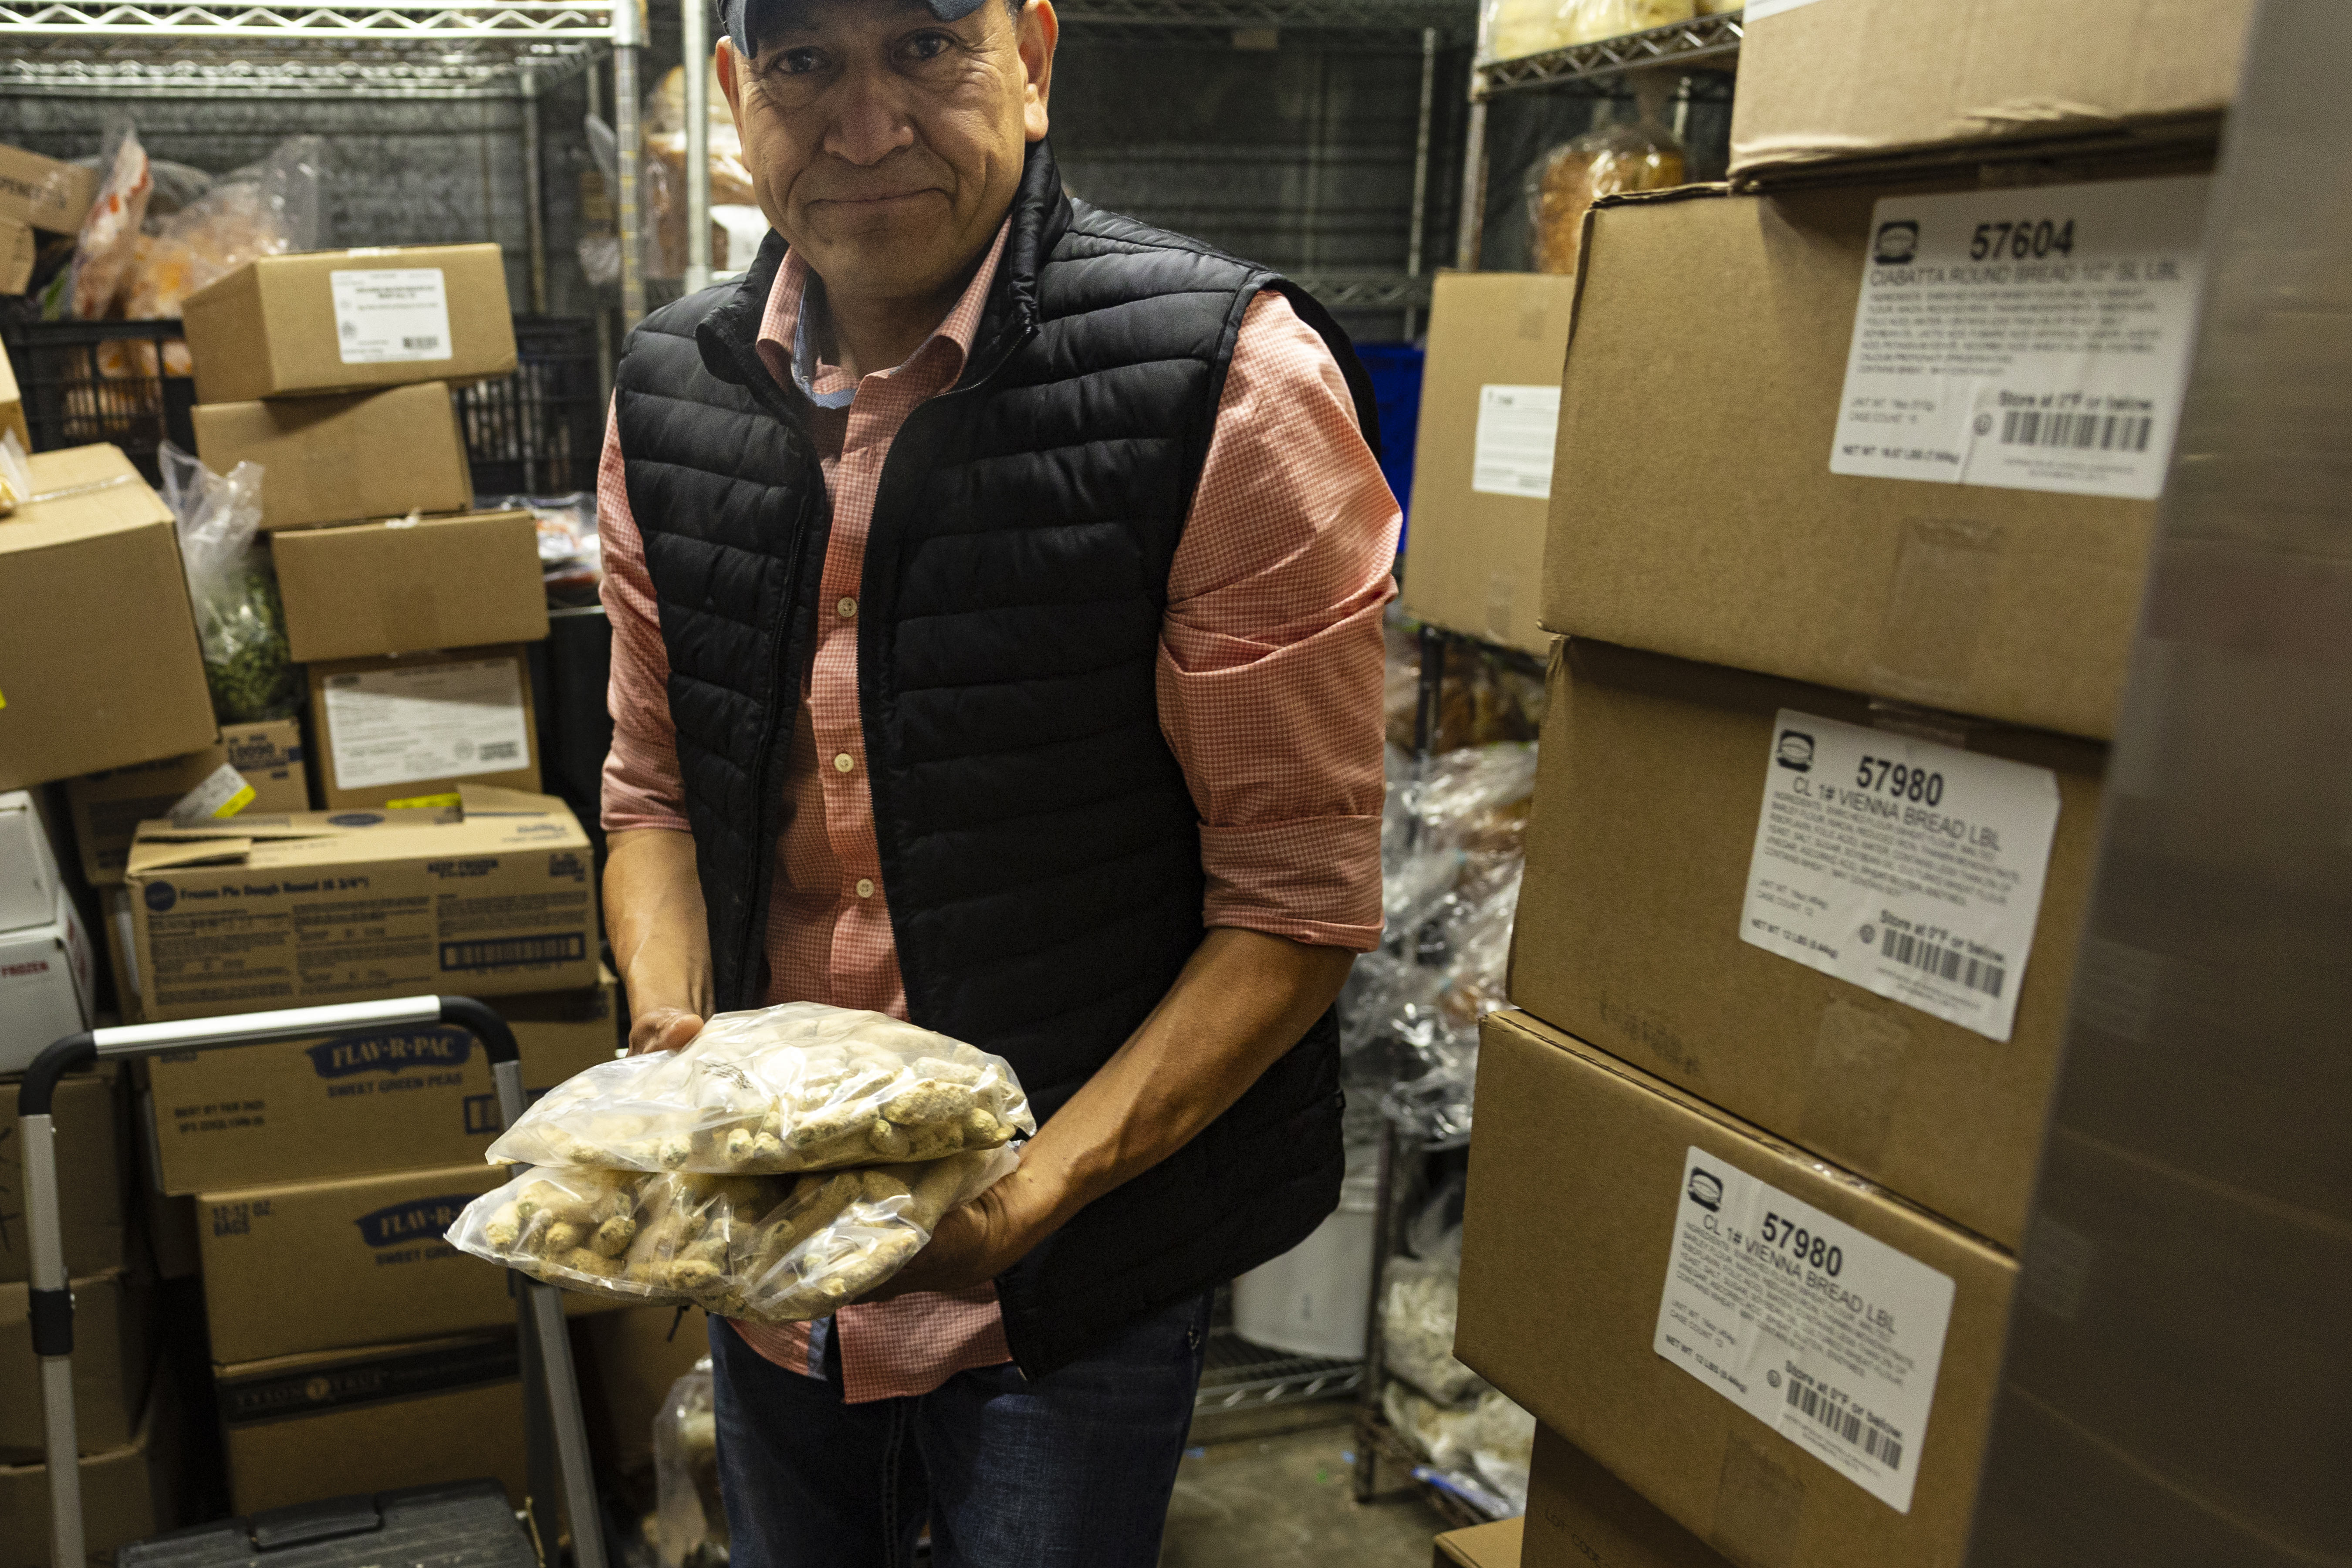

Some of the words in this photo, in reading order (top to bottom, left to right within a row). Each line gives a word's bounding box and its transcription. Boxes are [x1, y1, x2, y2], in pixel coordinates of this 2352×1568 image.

[1968, 217, 2078, 261] 57604
[1869, 267, 1946, 286] CIABATTA
[1948, 264, 2014, 285] ROUND
[2014, 262, 2077, 284] BREAD
[1997, 390, 2037, 407] Store
[1855, 754, 1946, 808] 57980
[1792, 775, 1814, 797] CL
[1817, 784, 1835, 801] 1#
[1837, 787, 1901, 821] VIENNA
[1903, 805, 1965, 840] BREAD
[1968, 823, 2004, 851] LBL
[180, 888, 218, 899] Frozen
[222, 886, 240, 896] Pie
[244, 882, 279, 896] Dough
[284, 880, 318, 892] Round
[1879, 908, 1912, 932] Store
[1914, 922, 1926, 936] at
[1950, 934, 1964, 950] or
[1967, 938, 2005, 963] below
[328, 1078, 373, 1096] SWEET
[378, 1076, 424, 1093] GREEN
[428, 1072, 462, 1088] PEAS
[214, 1218, 251, 1237] BAGS
[1761, 1210, 1845, 1279] 57980
[375, 1248, 420, 1267] SWEET
[1702, 1212, 1723, 1236] CL
[1725, 1226, 1742, 1246] 1#
[1744, 1236, 1804, 1282] VIENNA
[1805, 1268, 1865, 1315] BREAD
[1865, 1302, 1899, 1335] LBL
[1669, 1309, 1687, 1326] CASE
[1665, 1334, 1680, 1350] NET
[1703, 1358, 1719, 1375] LBS
[1784, 1358, 1815, 1387] Store
[1817, 1379, 1828, 1395] at
[1851, 1401, 1865, 1418] or
[1865, 1409, 1903, 1441] below
